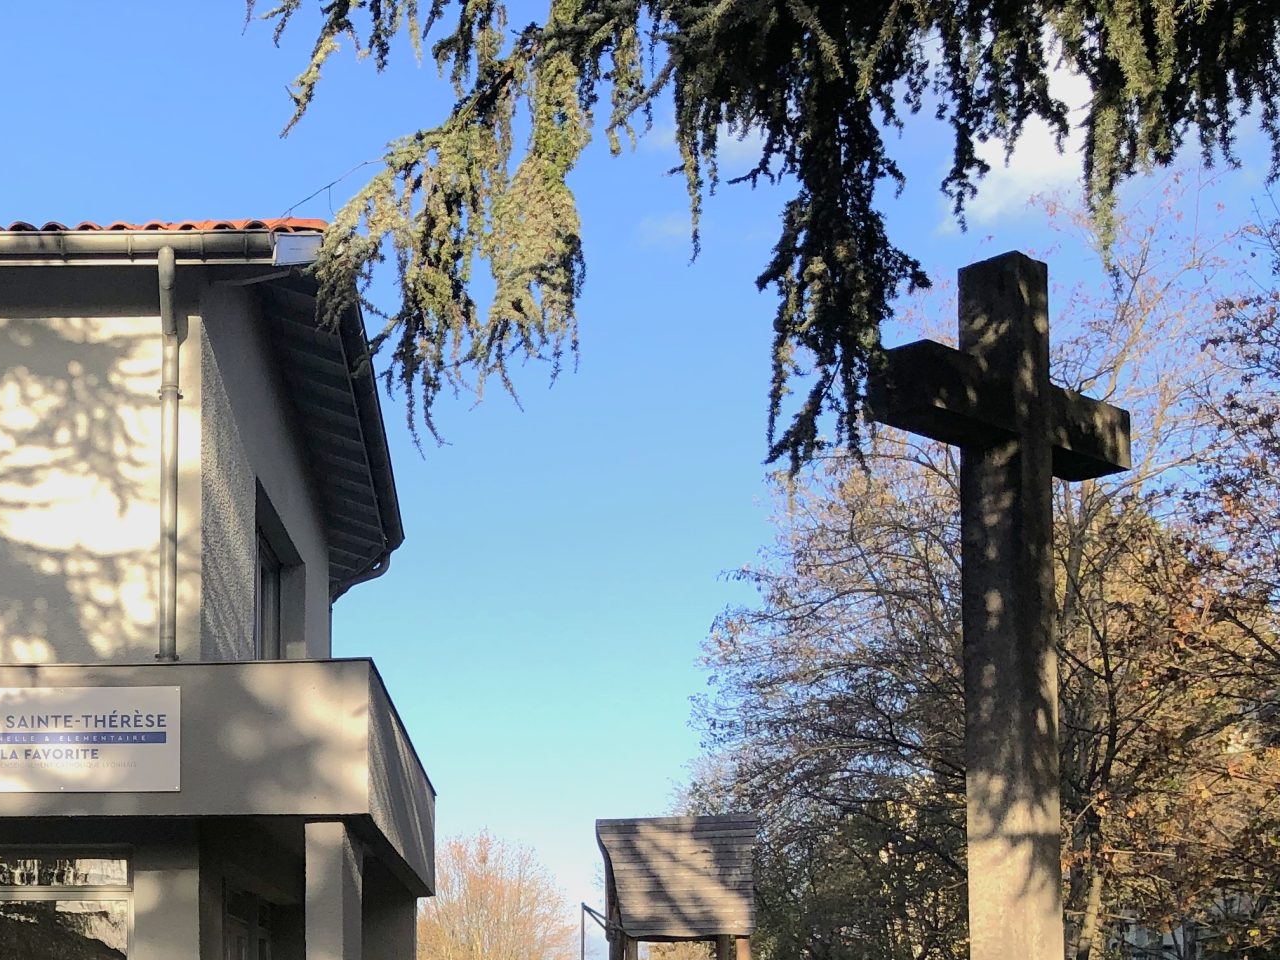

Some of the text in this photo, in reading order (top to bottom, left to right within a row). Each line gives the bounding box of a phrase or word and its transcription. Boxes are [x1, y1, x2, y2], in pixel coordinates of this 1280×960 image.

[6, 710, 167, 728] SAINTE-THÉRÈSE
[1, 749, 99, 760] LA FAVORITE
